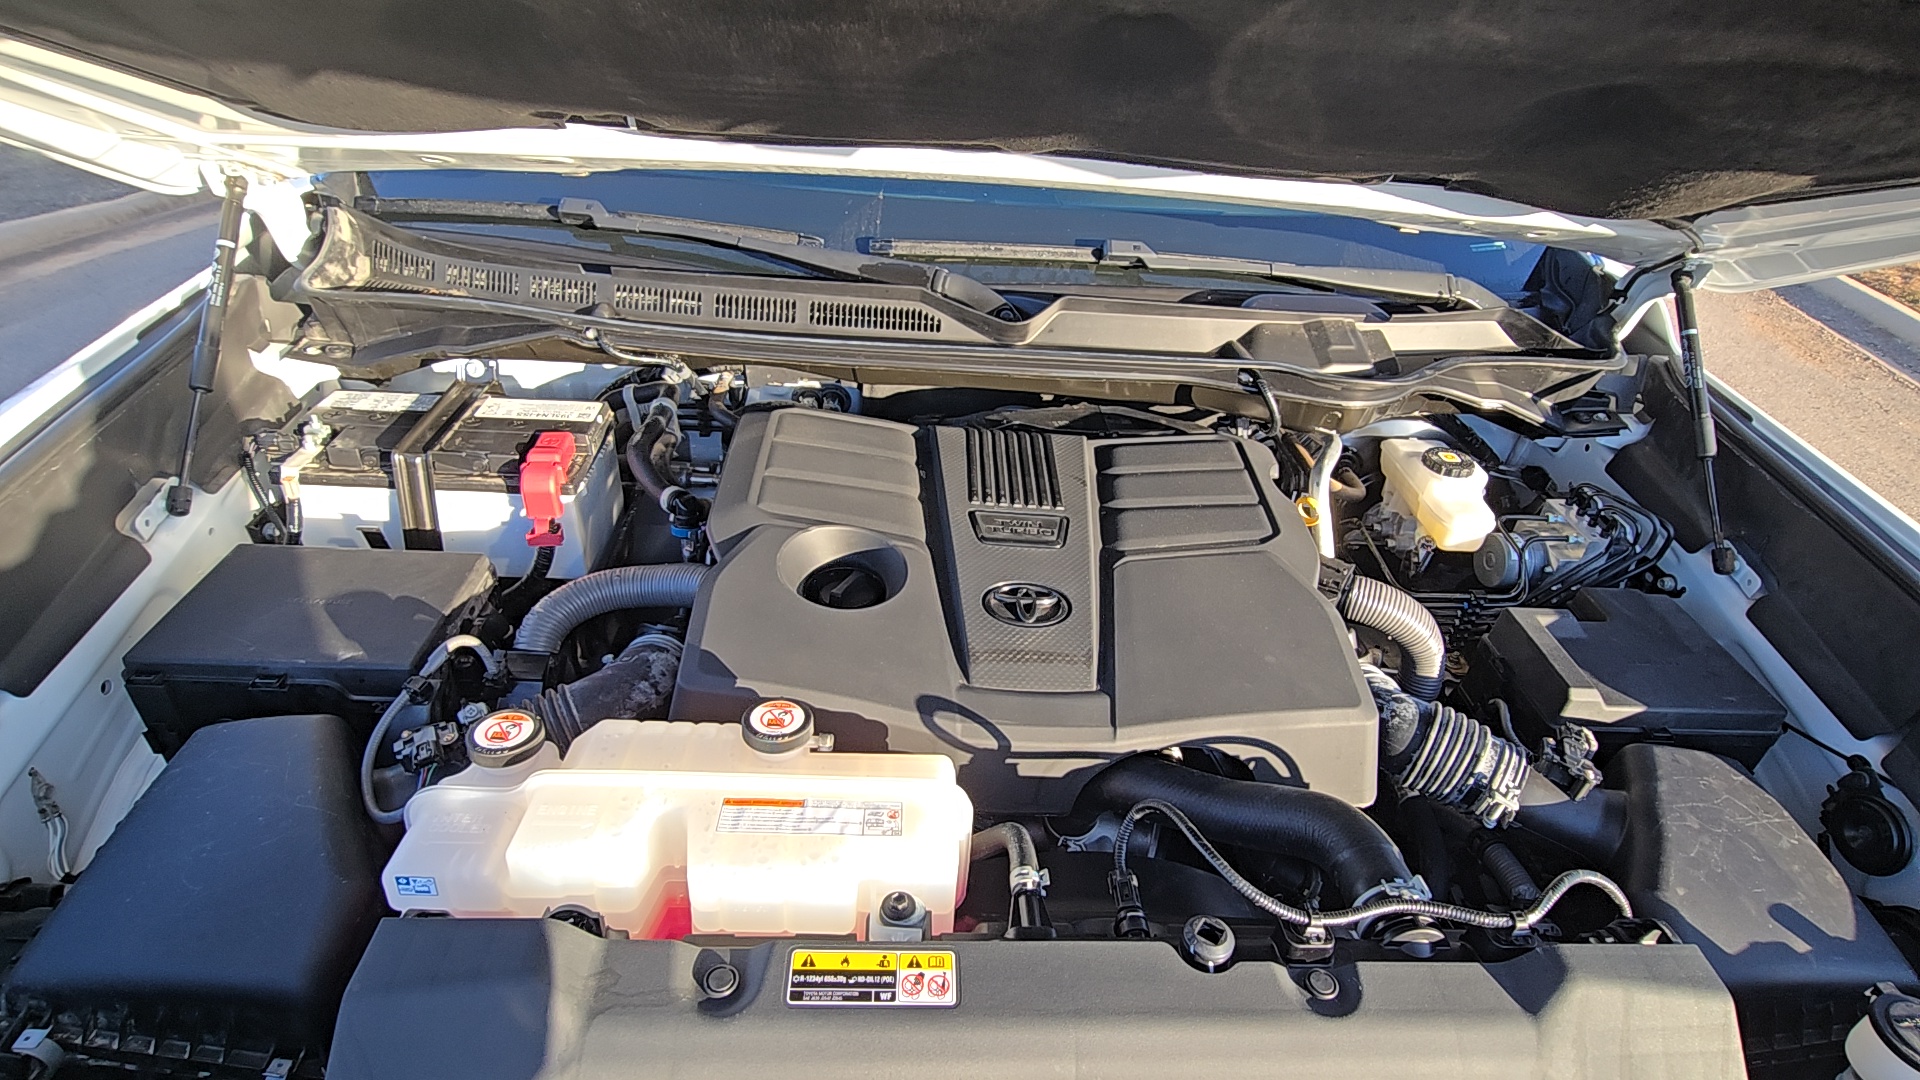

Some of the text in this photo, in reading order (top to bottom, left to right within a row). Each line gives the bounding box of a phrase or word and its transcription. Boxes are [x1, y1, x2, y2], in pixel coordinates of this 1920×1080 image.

[993, 518, 1043, 528] TWIN
[985, 524, 1056, 536] TURBO
[537, 804, 599, 816] ENGINE
[879, 992, 892, 1001] WF
